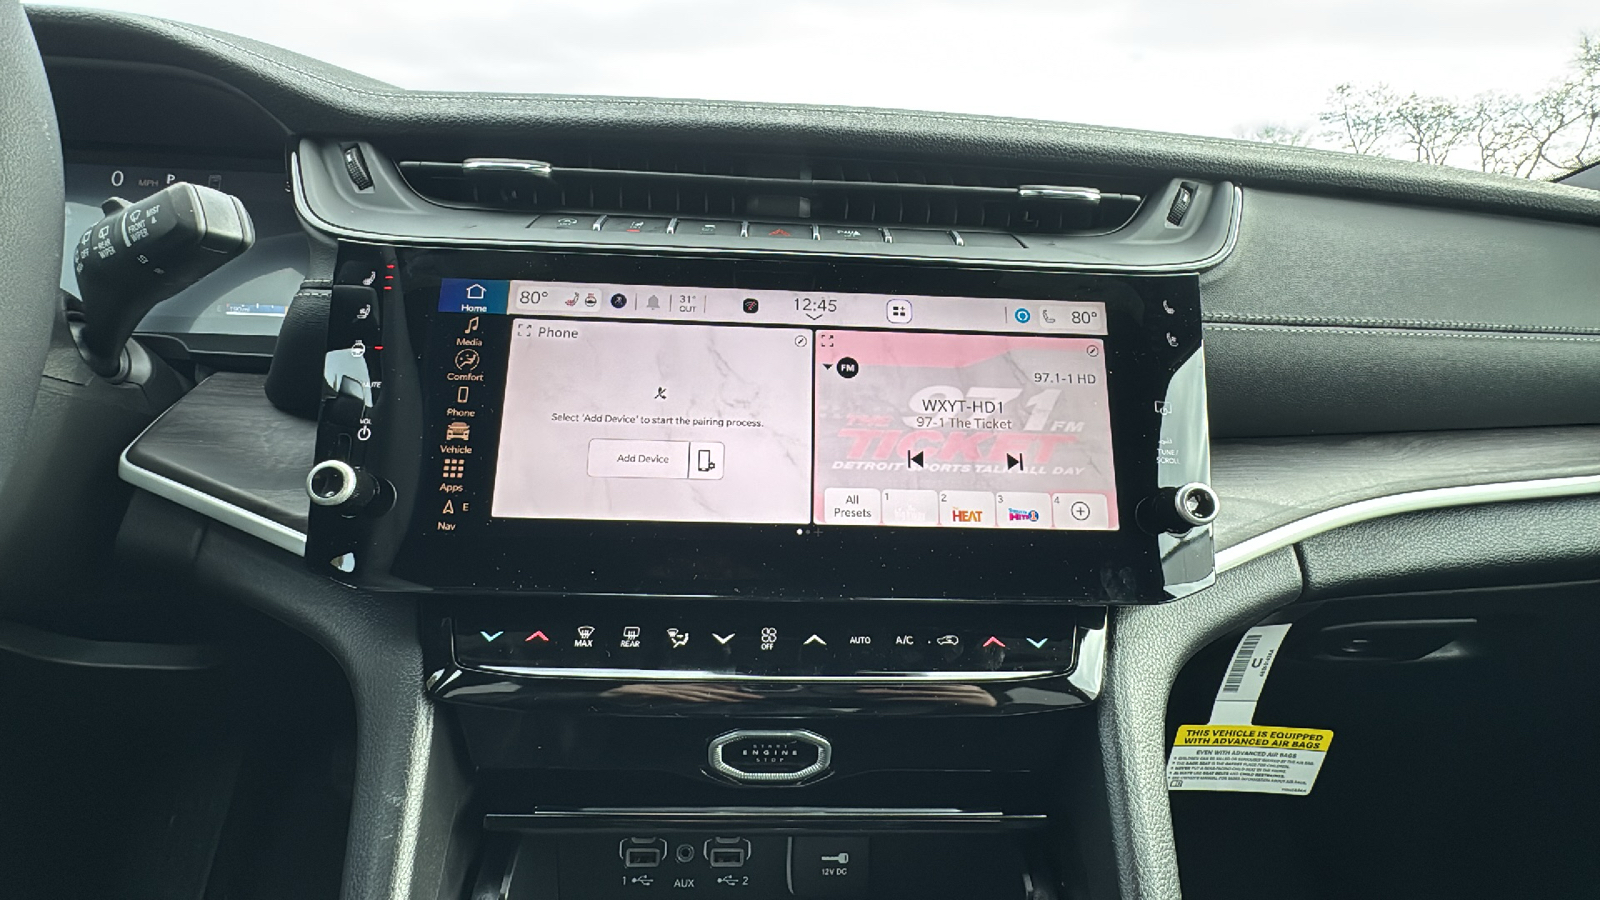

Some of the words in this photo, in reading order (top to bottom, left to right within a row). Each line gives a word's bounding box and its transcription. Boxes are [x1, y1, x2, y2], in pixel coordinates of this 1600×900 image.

[111, 170, 124, 187] 0
[138, 179, 159, 187] MPH
[166, 173, 176, 185] P
[146, 205, 160, 217] MIST
[128, 219, 146, 234] FRONT
[130, 228, 149, 242] WIPER
[97, 238, 112, 251] REAR
[518, 290, 549, 305] 80°
[461, 303, 488, 313] Home
[678, 305, 697, 313] OUT
[793, 298, 838, 313] 12:45
[1071, 310, 1098, 325] 80°
[537, 326, 579, 340] Phone
[456, 337, 483, 347] Media
[840, 364, 855, 373] FM
[447, 372, 484, 382] Comfort
[1034, 372, 1074, 384] 97.1-1
[1077, 374, 1097, 384] HD
[922, 398, 1004, 414] WXYT-HD1
[447, 407, 476, 418] Phone
[360, 417, 372, 426] VOL
[551, 412, 580, 423] Select
[640, 416, 651, 425] to
[652, 416, 673, 425] start
[675, 416, 691, 426] the
[692, 417, 724, 428] pairing
[726, 419, 764, 428] process.
[915, 416, 945, 429] 97-1
[948, 417, 972, 429] The
[974, 418, 1013, 430] Ticket
[1050, 420, 1085, 433] FM
[440, 444, 473, 455] Vehicle
[837, 428, 1078, 464] TICKET
[616, 454, 636, 463] Add
[638, 454, 670, 464] Device
[1156, 456, 1180, 465] SCROLL
[831, 460, 902, 471] DETROIT
[1051, 465, 1085, 476] DAY
[439, 482, 464, 494] Apps
[846, 494, 860, 505] All
[884, 492, 889, 501] 1
[940, 493, 948, 503] 2
[997, 494, 1004, 504] 3
[1053, 496, 1061, 504] 4
[461, 502, 470, 512] E
[833, 507, 873, 519] Presets
[951, 510, 983, 523] HEAT
[437, 520, 457, 532] Nav
[574, 639, 593, 648] MAX
[620, 639, 641, 648] REAR
[849, 635, 871, 645] AUTO
[895, 634, 915, 645] A/C
[760, 643, 774, 651] OFF
[1186, 729, 1210, 737] THIS
[1212, 730, 1255, 738] VEHICLE
[1256, 731, 1268, 739] IS
[1270, 731, 1324, 742] EQUIPPED
[1184, 737, 1210, 745] WITH
[1212, 738, 1269, 747] ADVANCED
[1271, 740, 1290, 748] AIR
[1291, 740, 1321, 750] BAGS
[1231, 750, 1266, 758] ADVANCED
[821, 868, 835, 876] 12V
[836, 868, 848, 876] DC
[622, 875, 627, 886] 1
[673, 878, 695, 889] AUX
[742, 876, 749, 887] 2
